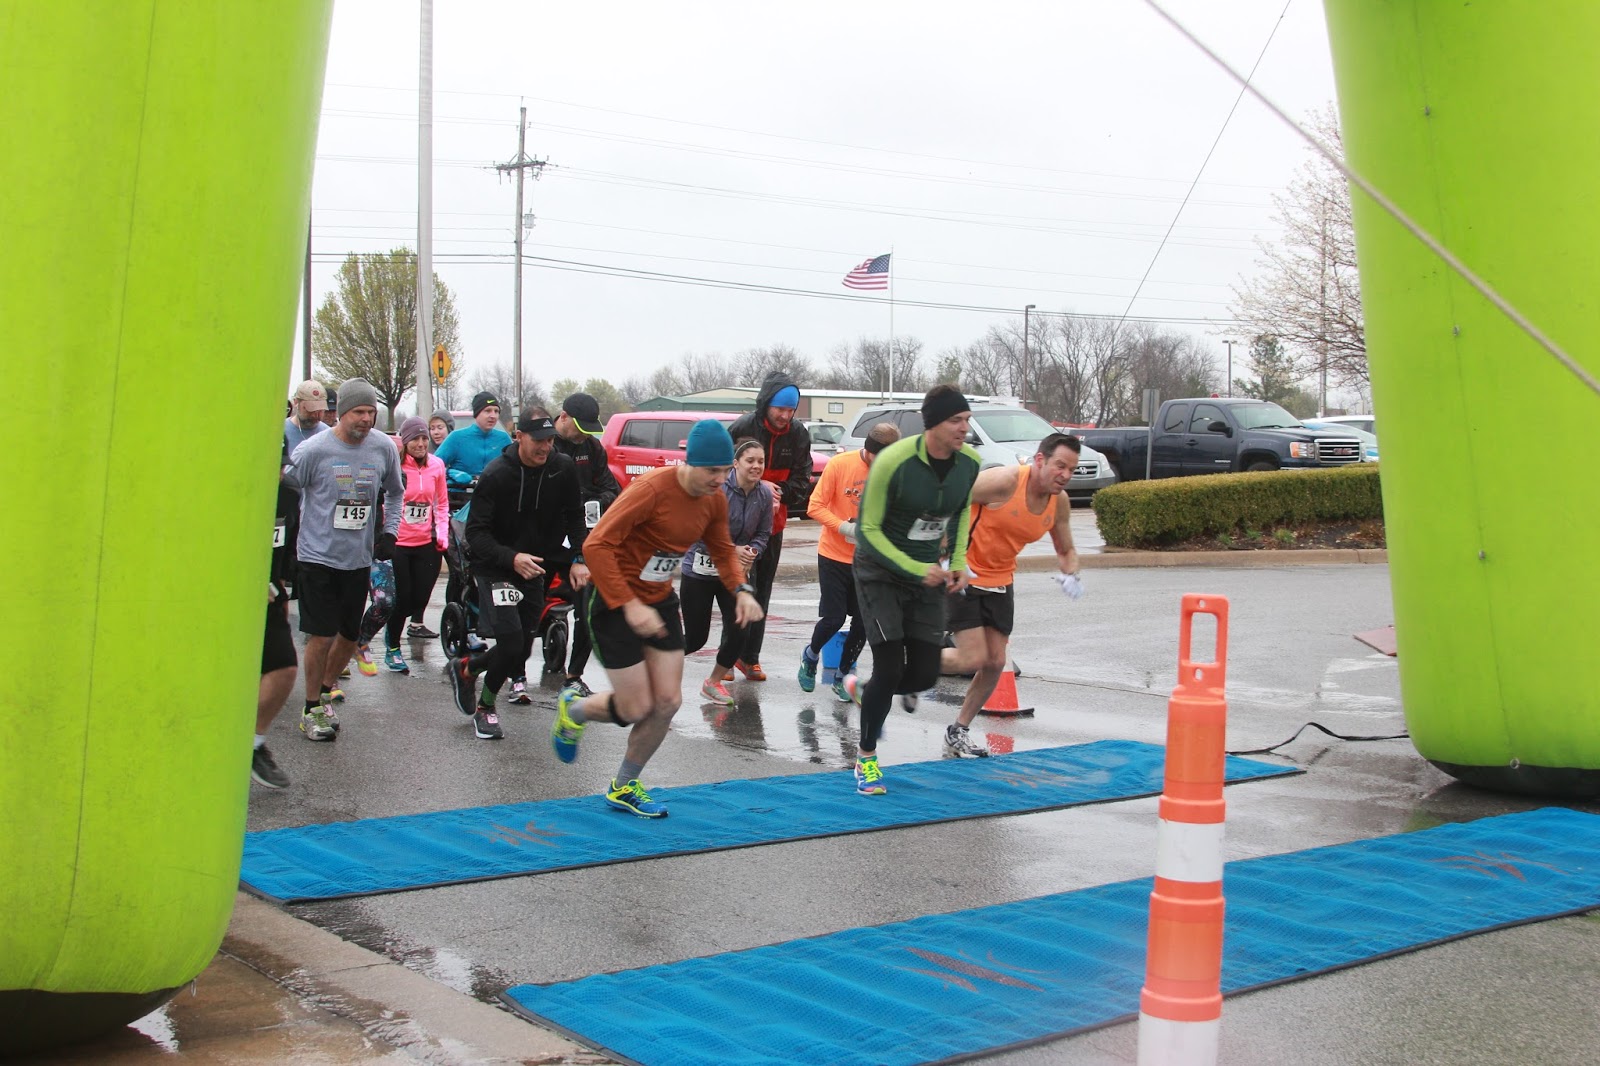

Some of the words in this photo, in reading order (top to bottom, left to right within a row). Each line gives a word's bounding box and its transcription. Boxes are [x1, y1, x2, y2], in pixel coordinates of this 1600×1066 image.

[342, 507, 366, 520] 145
[410, 507, 427, 518] 116
[699, 556, 716, 568] 14
[500, 590, 520, 602] 168
